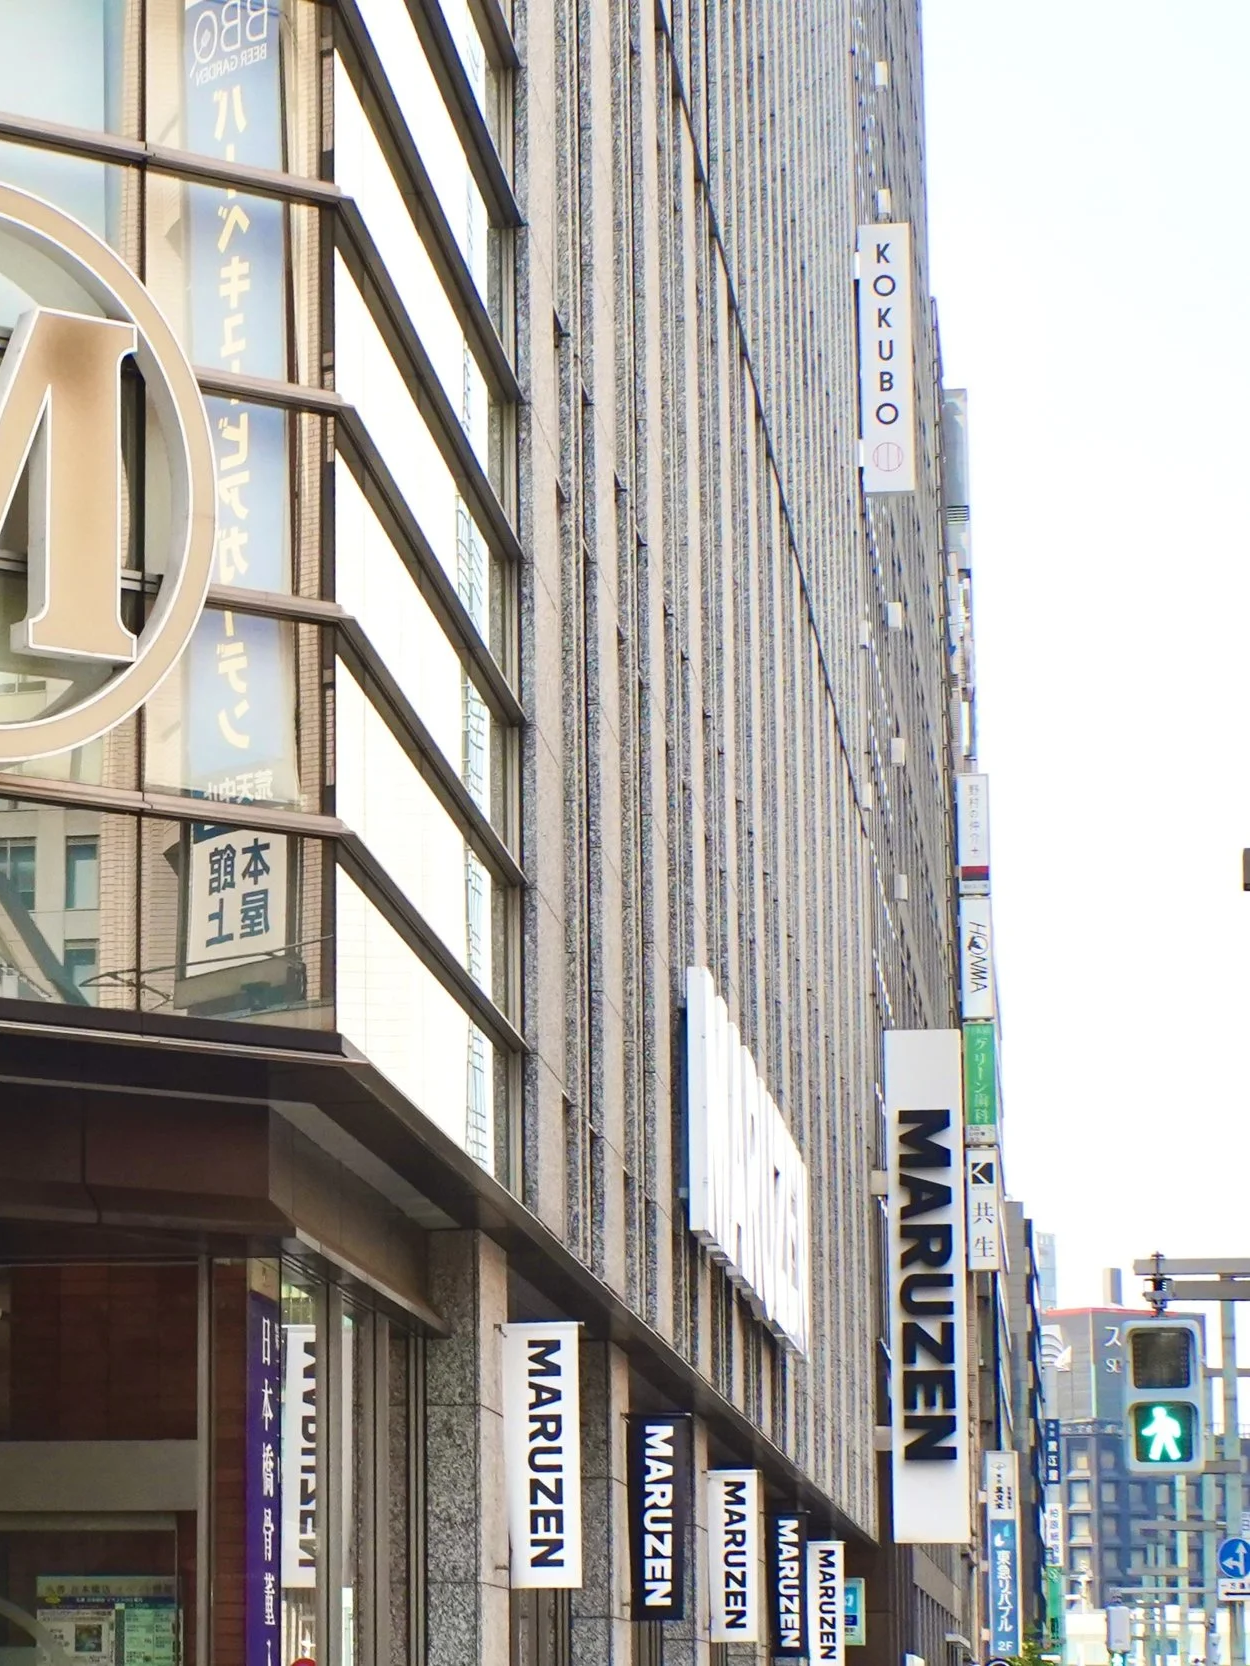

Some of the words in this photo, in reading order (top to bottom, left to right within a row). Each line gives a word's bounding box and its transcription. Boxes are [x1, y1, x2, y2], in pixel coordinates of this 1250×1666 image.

[873, 242, 899, 425] KOKUBO
[967, 921, 988, 993] HONMA
[898, 1109, 957, 1461] MARUZEN
[973, 1202, 996, 1257] 共生
[528, 1339, 565, 1569] MARUZEN
[643, 1424, 674, 1607] MARUZEN
[724, 1480, 748, 1630] MARUZEN
[777, 1519, 801, 1648] MARUZEN
[818, 1549, 837, 1660] MARUZEN
[996, 1550, 1014, 1633] 東急リバブル
[997, 1641, 1013, 1652] 2F
